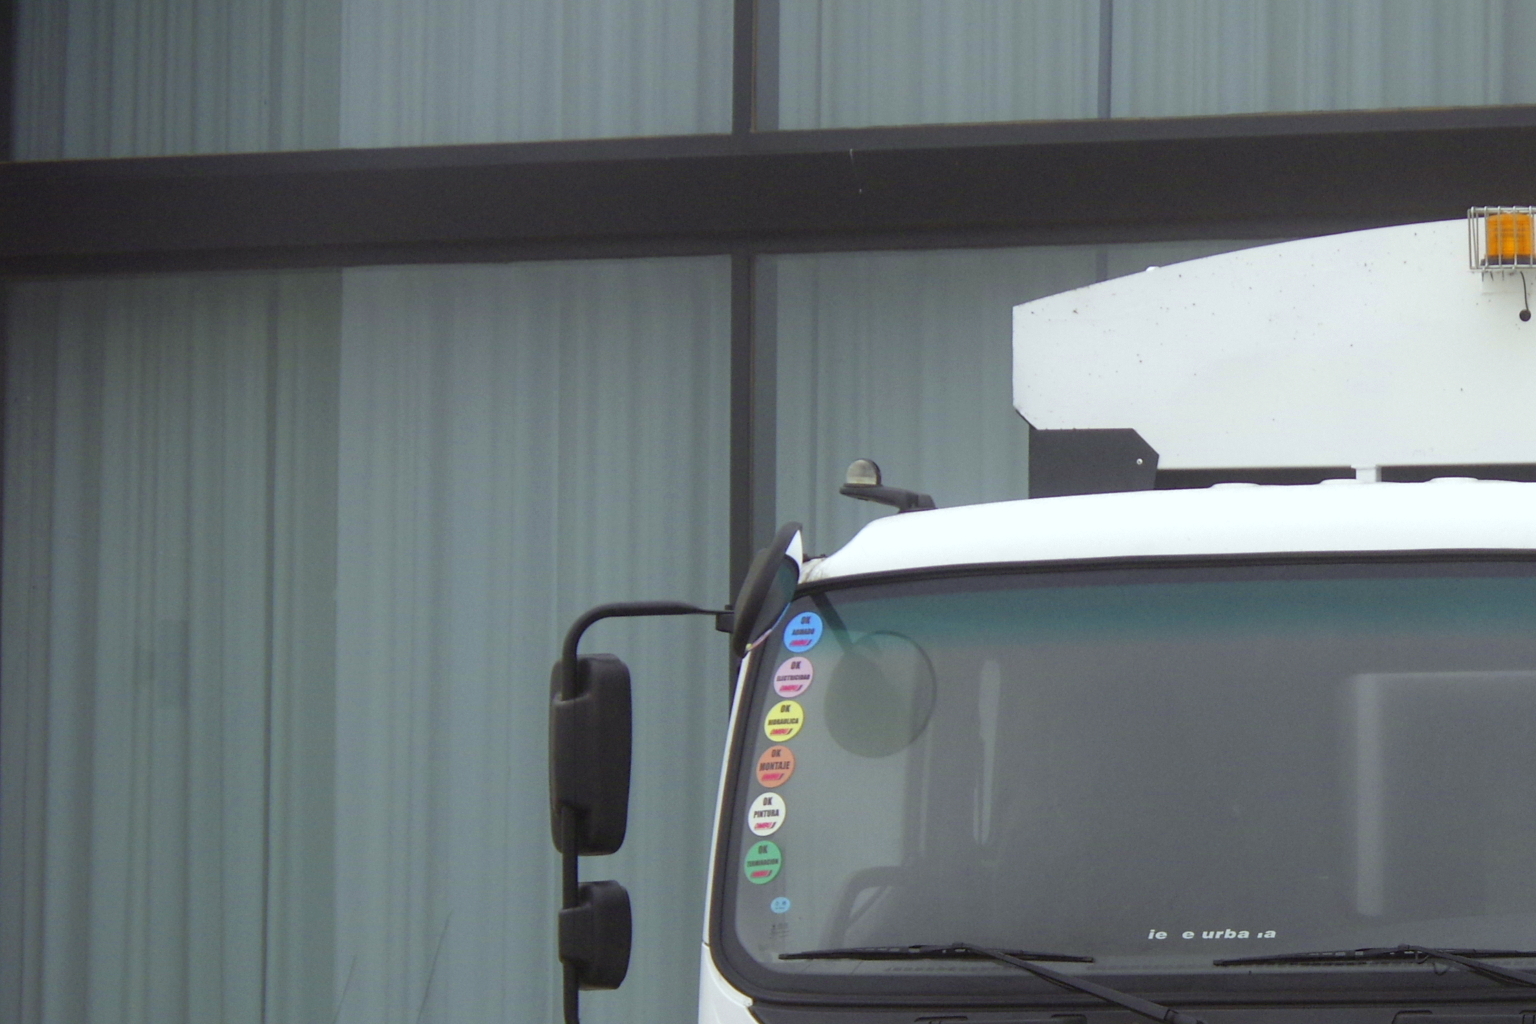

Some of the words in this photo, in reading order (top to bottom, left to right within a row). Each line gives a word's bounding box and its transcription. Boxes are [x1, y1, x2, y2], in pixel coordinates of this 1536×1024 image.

[801, 616, 811, 624] OK
[790, 661, 801, 669] OK
[780, 705, 790, 713] OK
[771, 749, 781, 757] OK
[759, 761, 790, 771] MONTAJE
[763, 797, 772, 806] OK
[753, 809, 779, 818] PINTURA
[758, 845, 767, 854] OK
